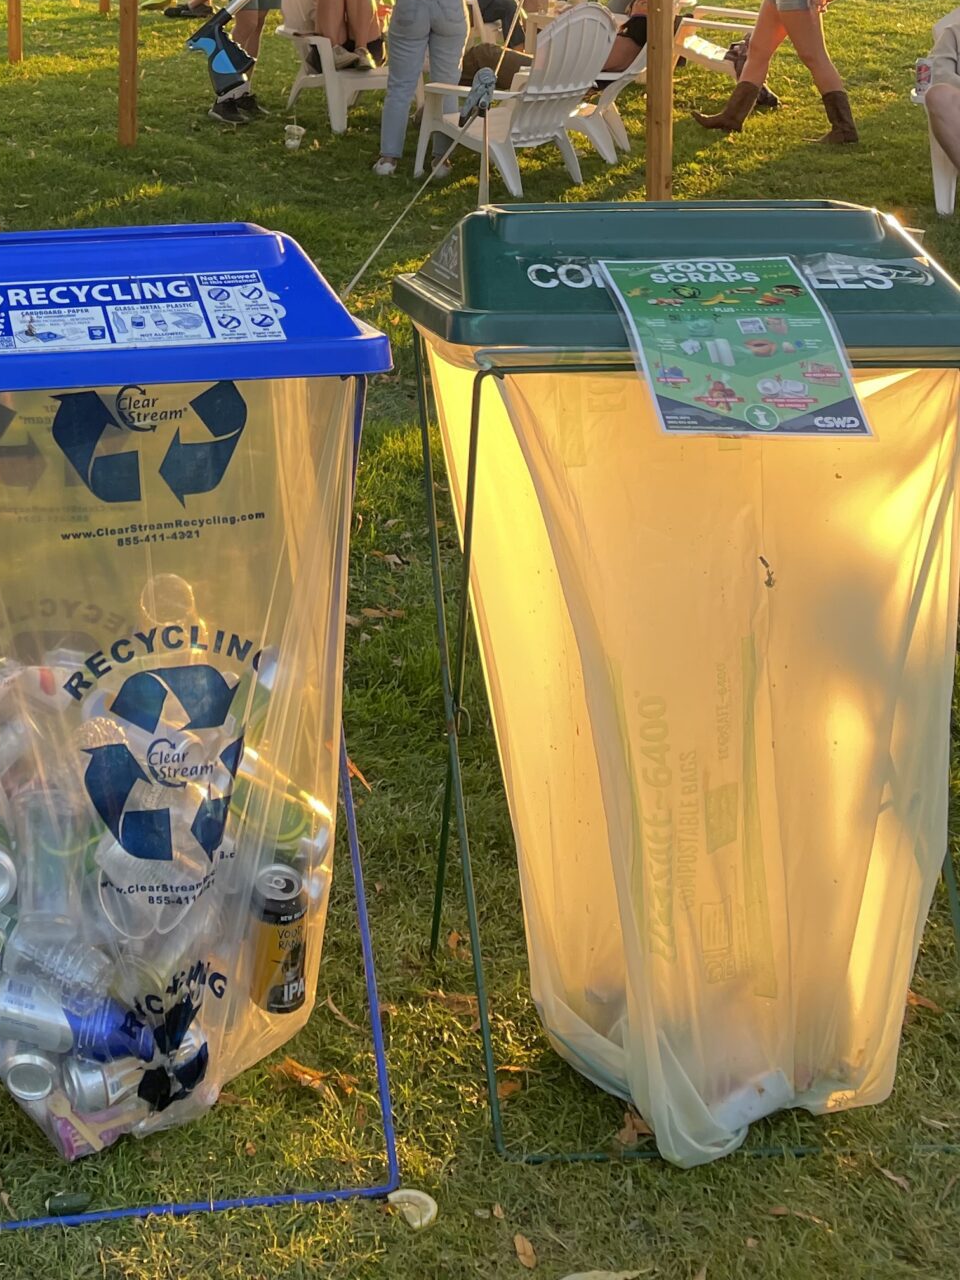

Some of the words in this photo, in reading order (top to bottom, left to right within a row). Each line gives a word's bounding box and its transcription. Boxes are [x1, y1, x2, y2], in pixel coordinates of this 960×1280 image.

[661, 262, 736, 273] FOOD
[220, 273, 256, 281] allowed
[650, 272, 761, 283] SCRAPS
[7, 280, 192, 307] RECYCLING
[117, 394, 159, 411] Clear
[814, 416, 860, 428] CSWD
[61, 511, 266, 541] www.ClearStreamRecycling.com
[148, 749, 189, 765] Clear
[678, 750, 698, 794] BAGS
[283, 977, 305, 1002] IPA
